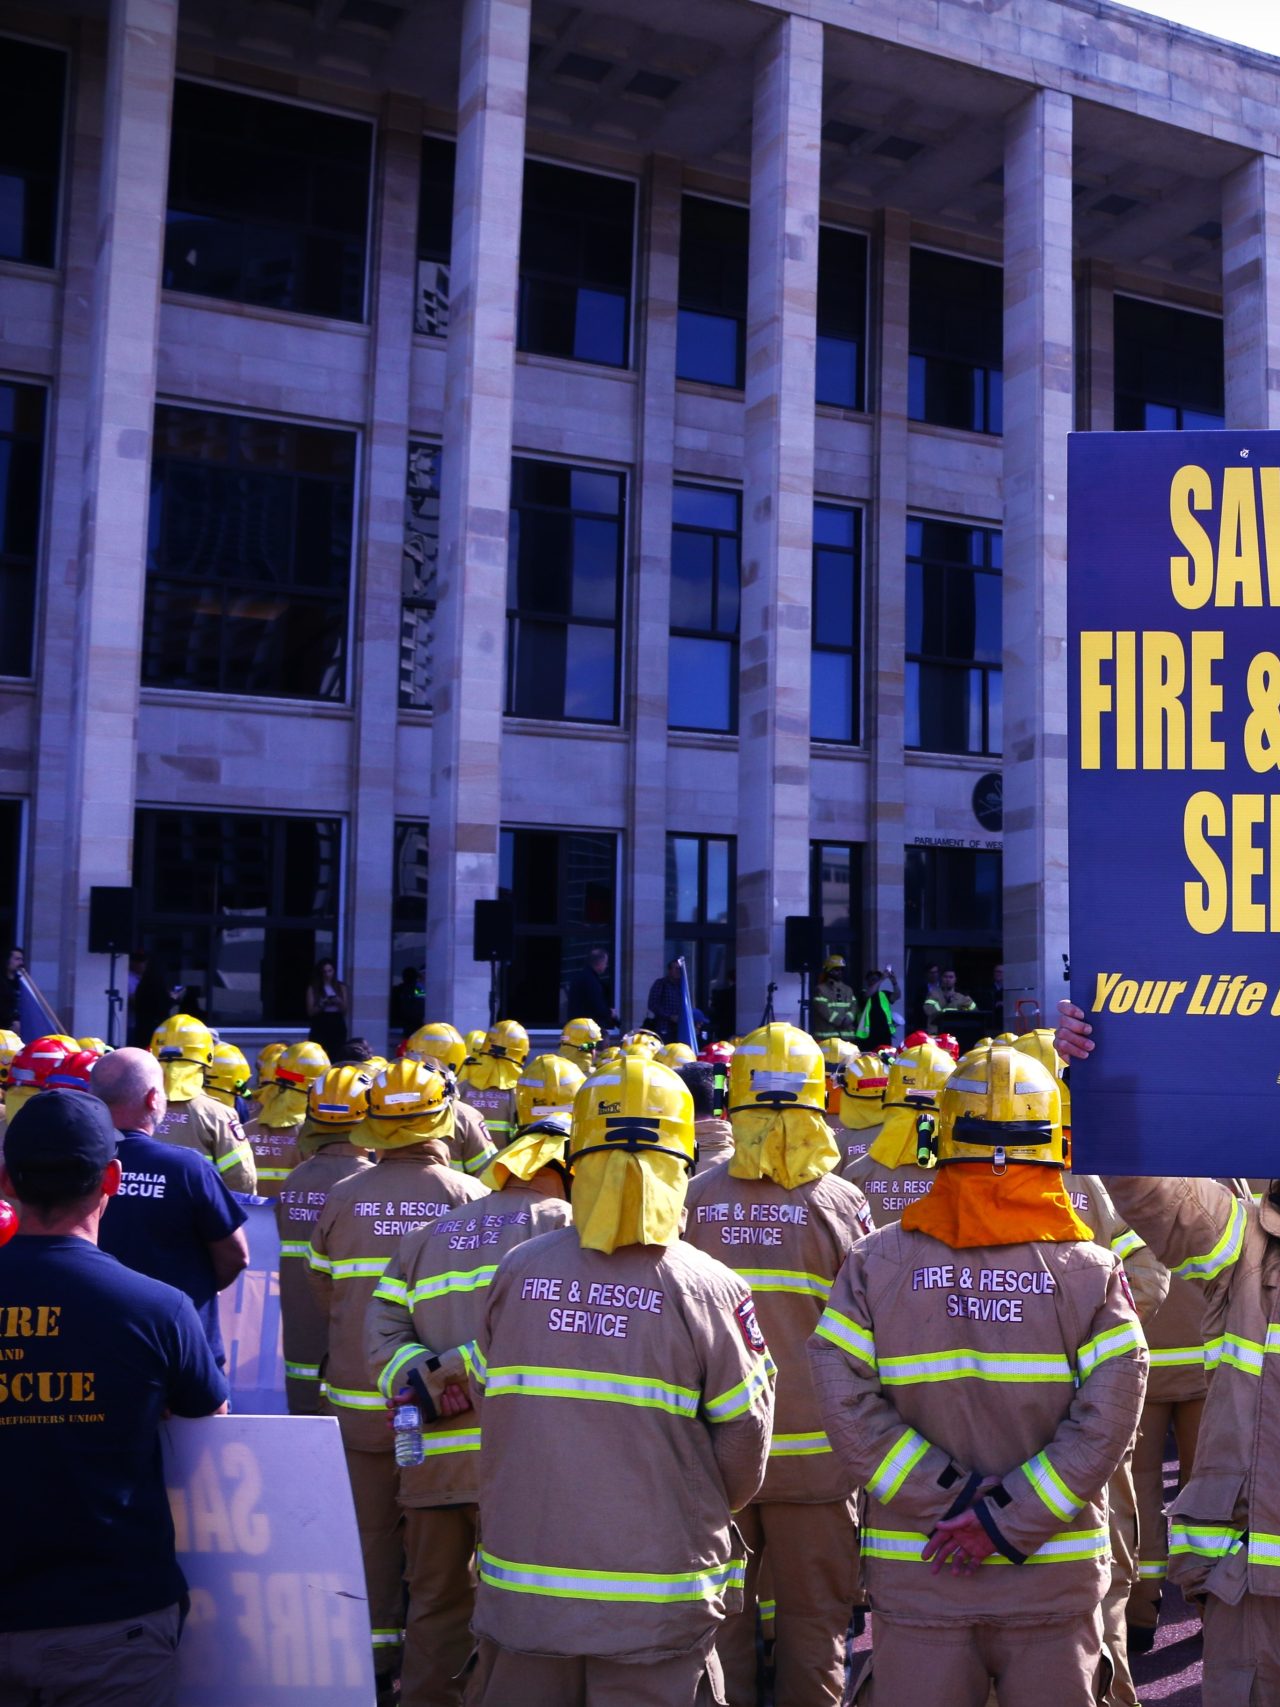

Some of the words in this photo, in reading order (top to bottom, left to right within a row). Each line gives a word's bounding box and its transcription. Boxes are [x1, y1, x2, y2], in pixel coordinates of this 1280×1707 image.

[1080, 631, 1226, 770] FIRE
[914, 836, 965, 848] PARLIAMENT
[968, 840, 982, 848] OF
[1092, 972, 1186, 1015] Your
[1188, 974, 1268, 1016] Life
[847, 1143, 868, 1156] FIRE
[120, 1171, 167, 1184] TRALIA
[865, 1180, 889, 1194] FIRE
[891, 1180, 900, 1194] &
[903, 1180, 934, 1194] RESC
[117, 1182, 165, 1199] SCUE
[354, 1202, 381, 1217] FIRE
[385, 1202, 395, 1217] &
[696, 1202, 729, 1224] FIRE
[733, 1202, 745, 1222] &
[750, 1203, 809, 1226] RESCUE
[465, 1218, 477, 1233] &
[720, 1225, 783, 1246] SERVICE
[912, 1264, 956, 1291] FIRE
[959, 1266, 973, 1290] &
[978, 1268, 1056, 1295] RESCUE
[520, 1277, 563, 1302] FIRE
[568, 1280, 581, 1304] &
[587, 1282, 664, 1314] RESCUE
[946, 1294, 1023, 1323] SERVICE
[547, 1307, 629, 1338] SERVICE
